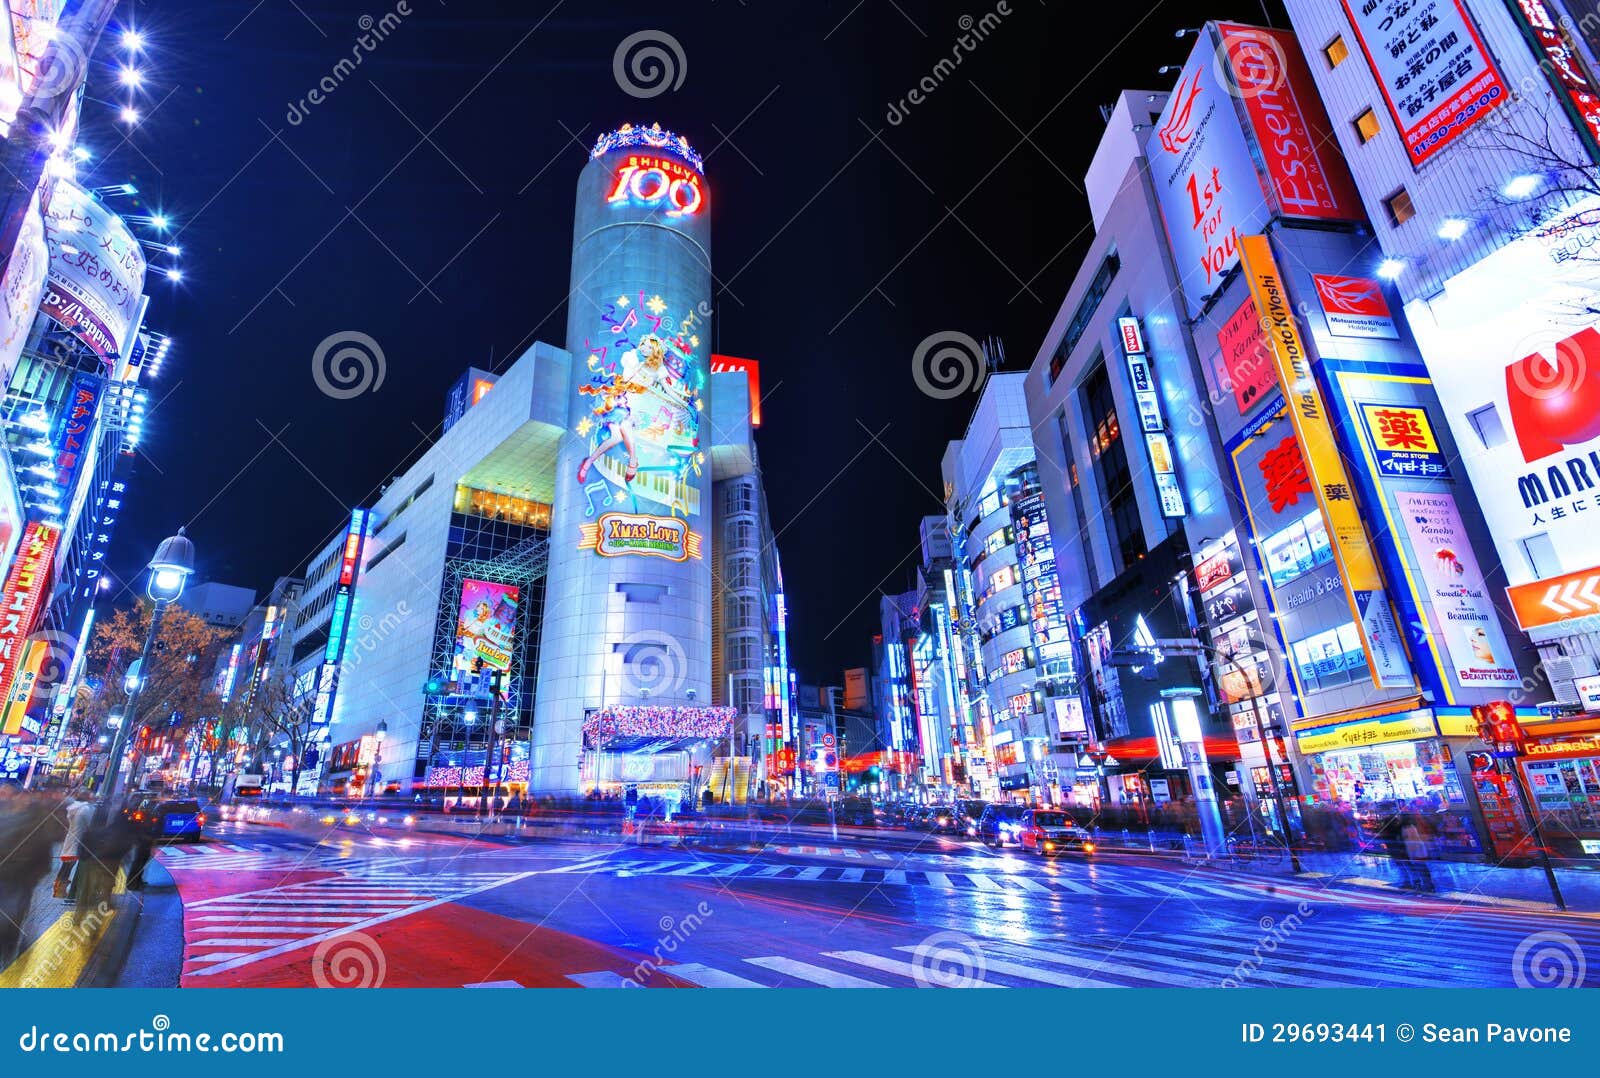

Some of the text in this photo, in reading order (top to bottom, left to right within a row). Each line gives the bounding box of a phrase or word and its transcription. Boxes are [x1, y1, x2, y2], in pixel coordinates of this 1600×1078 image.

[1390, 14, 1439, 59] 卵と私
[1395, 31, 1459, 91] お茶の間
[1407, 58, 1474, 118] 餃子屋台
[608, 165, 702, 218] 109
[629, 156, 700, 186] SHIBUYA
[1186, 166, 1223, 231] 1st
[1202, 205, 1223, 243] for
[1259, 274, 1290, 330] KiYoshi
[1280, 326, 1320, 420] Maumoto
[1374, 409, 1428, 449] 薬
[1323, 483, 1351, 502] 薬
[1286, 585, 1315, 609] Health
[1316, 582, 1324, 595] &
